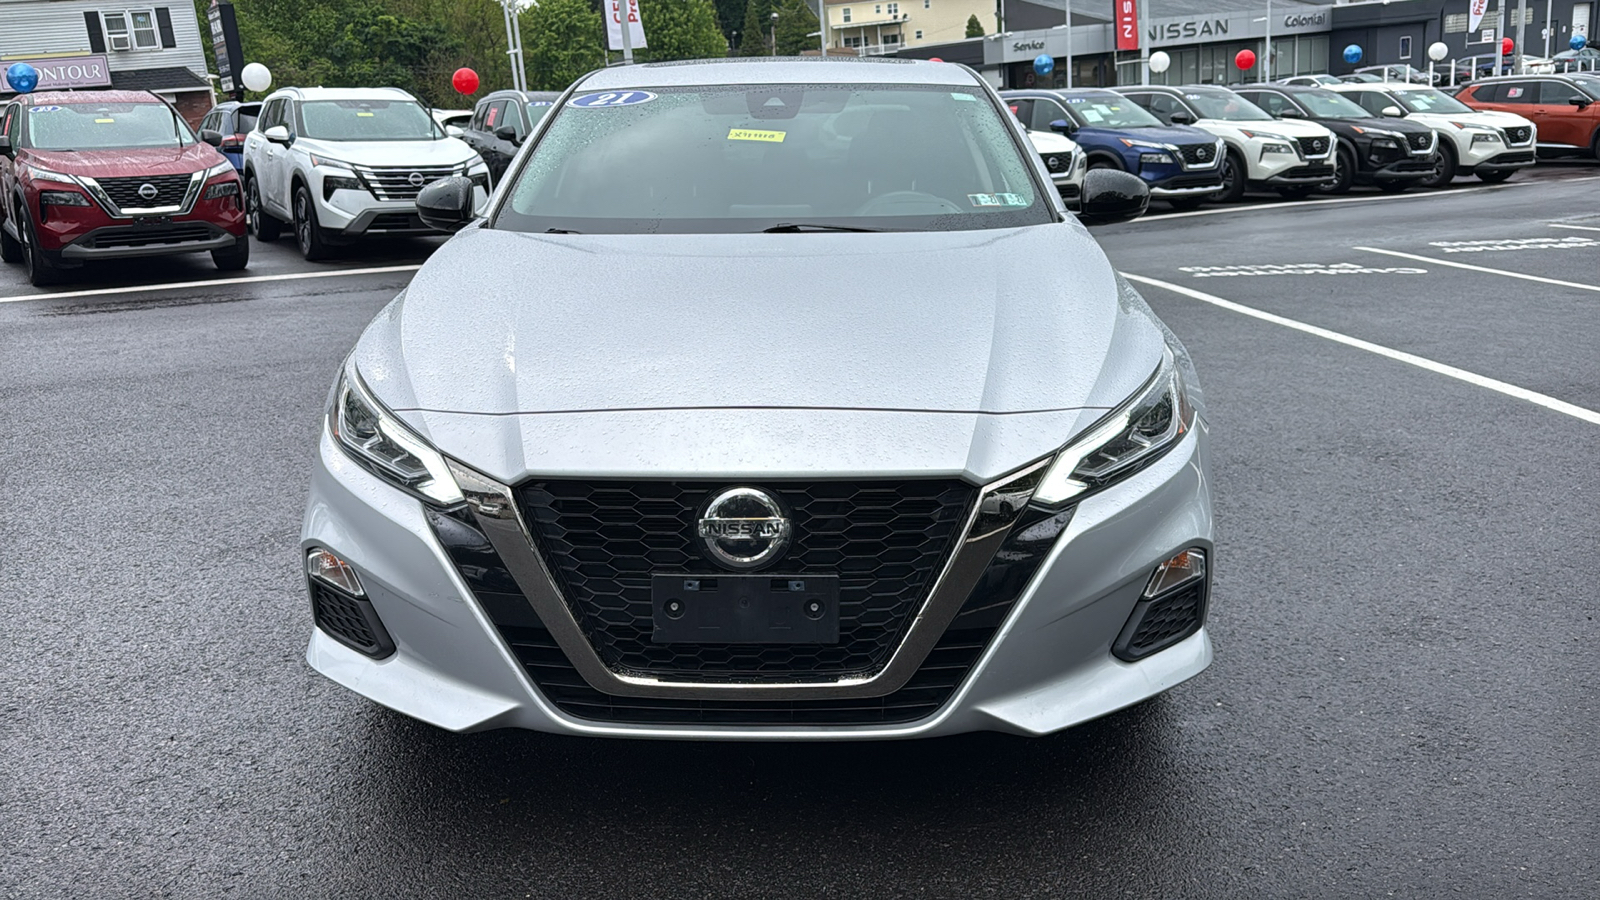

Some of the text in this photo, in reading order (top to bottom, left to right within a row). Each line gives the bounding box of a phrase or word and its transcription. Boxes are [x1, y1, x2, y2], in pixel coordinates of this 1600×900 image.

[1284, 12, 1326, 28] Colonial
[1013, 40, 1045, 52] Service
[588, 92, 635, 106] 21
[707, 523, 780, 535] NISSAN
